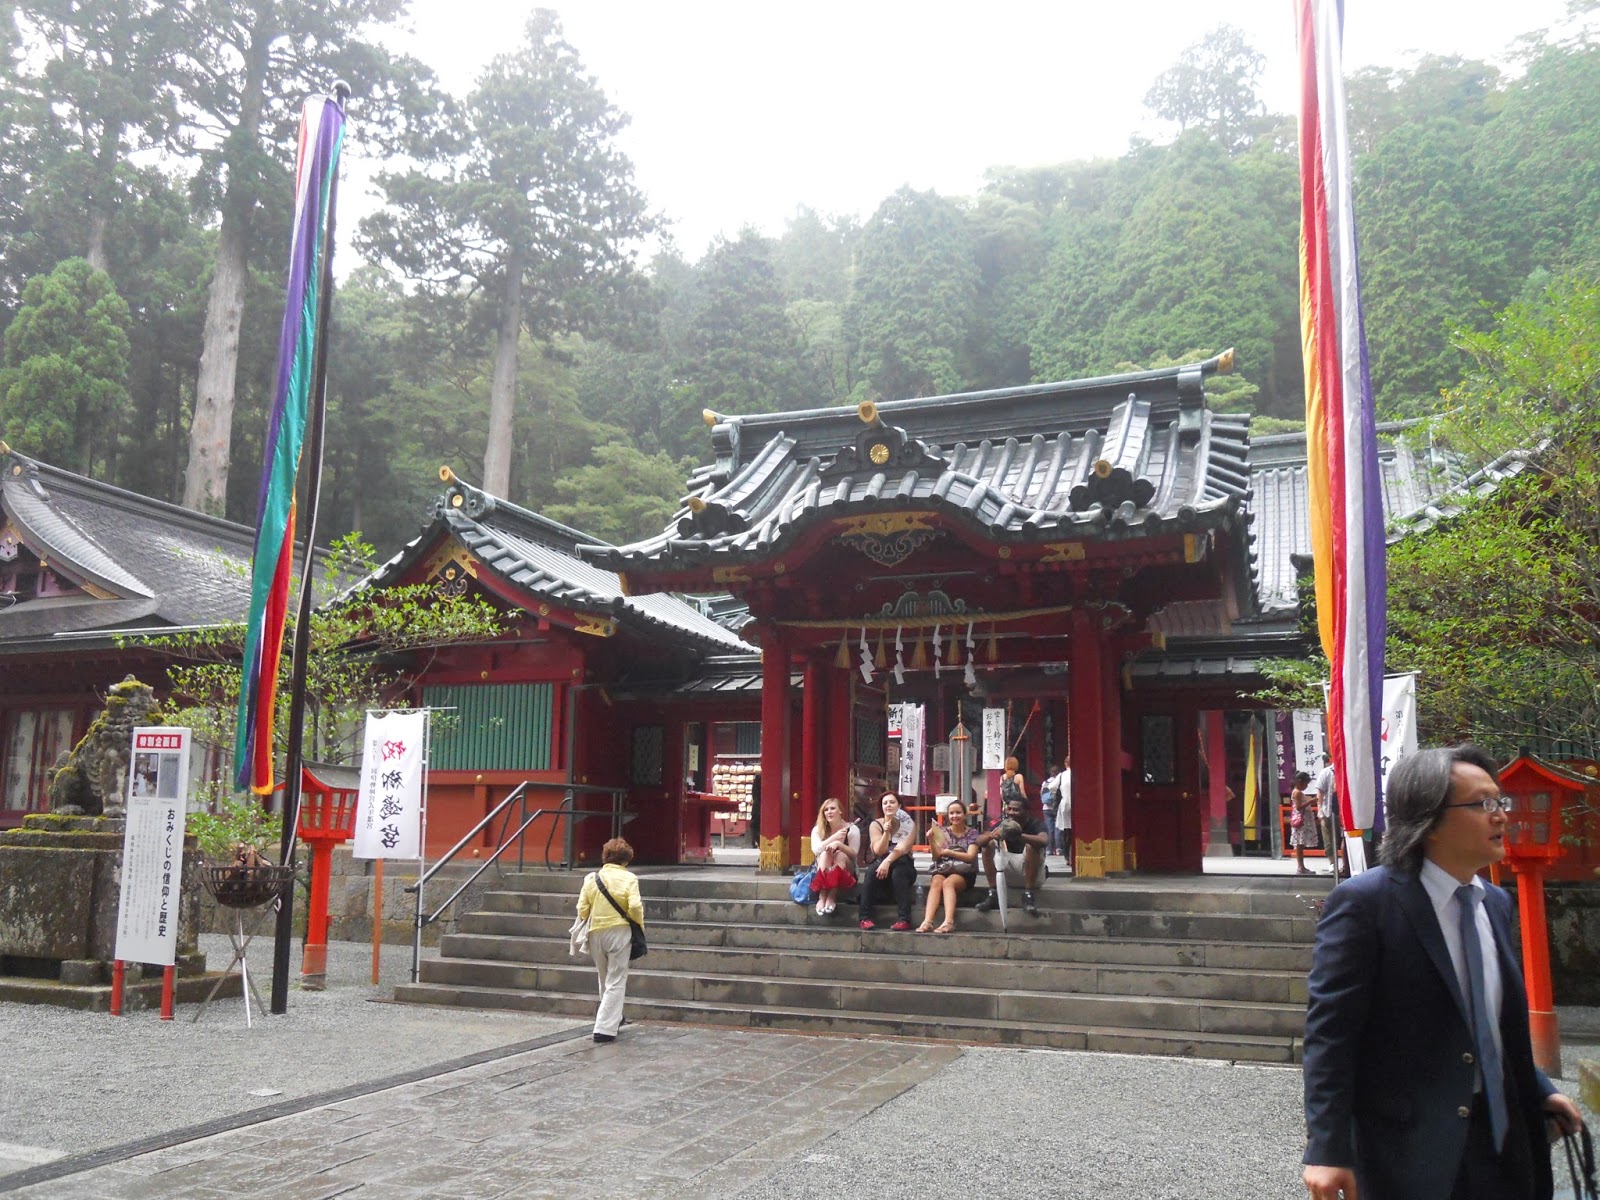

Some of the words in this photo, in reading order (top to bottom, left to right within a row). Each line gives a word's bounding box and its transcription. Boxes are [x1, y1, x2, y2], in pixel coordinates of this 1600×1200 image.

[139, 735, 179, 748] 特別企画展
[1303, 730, 1317, 780] 箱根神社
[158, 808, 175, 937] おみくじの信仰と歴史
